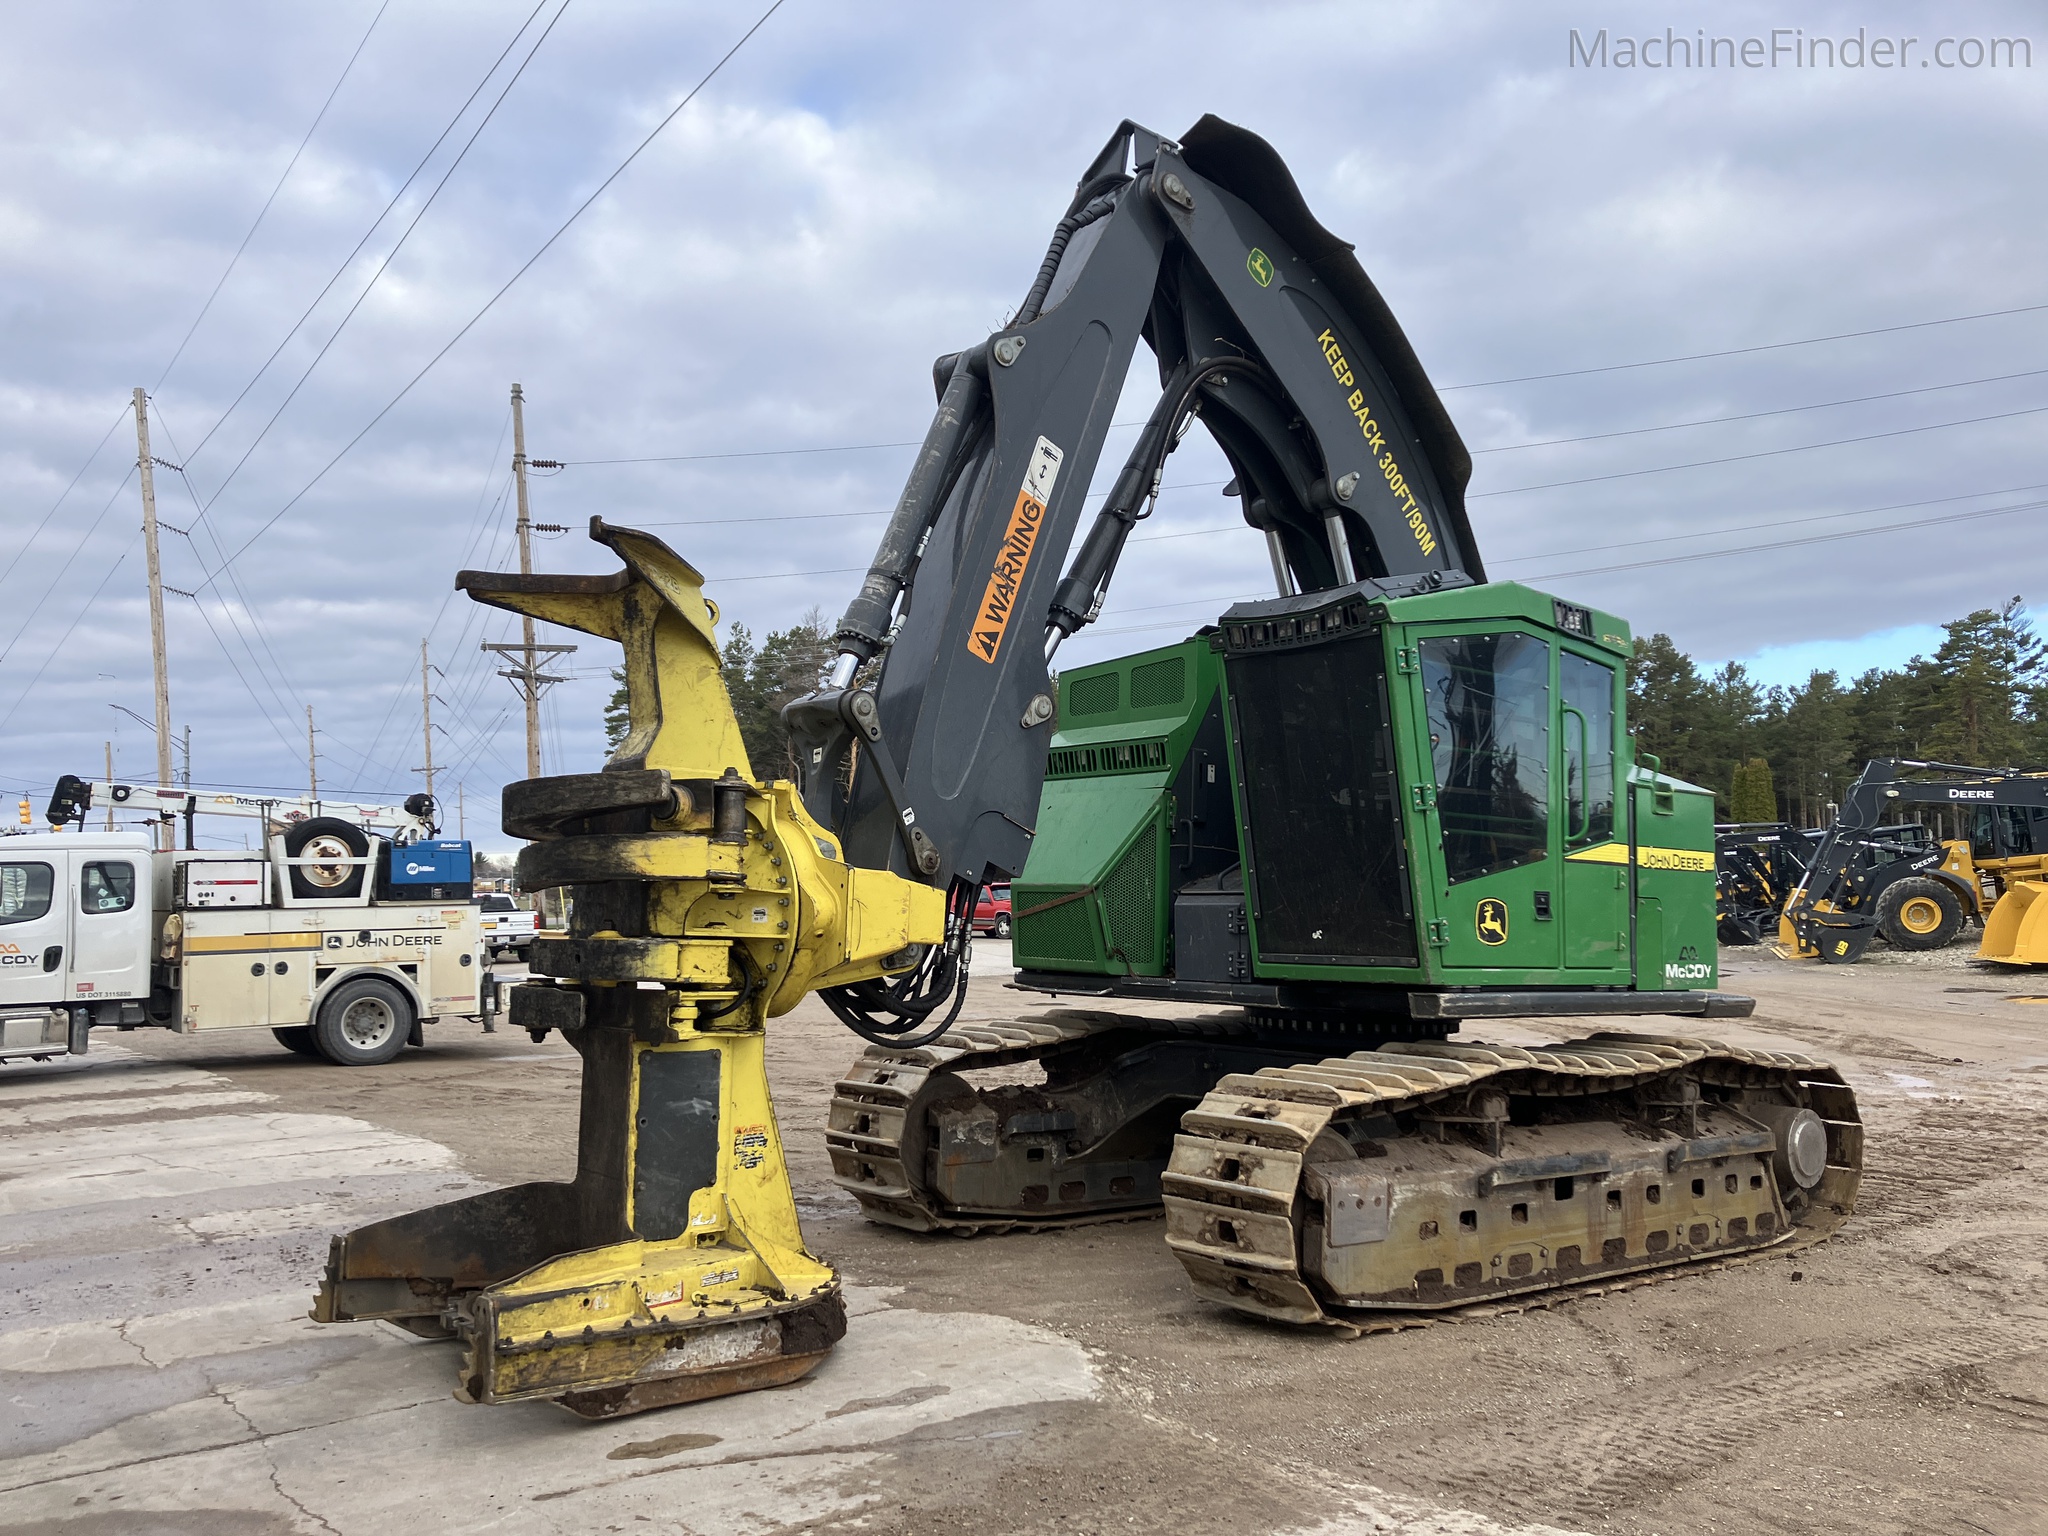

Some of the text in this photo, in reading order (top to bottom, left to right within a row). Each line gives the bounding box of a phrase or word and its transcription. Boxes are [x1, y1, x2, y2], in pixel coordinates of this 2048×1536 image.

[1316, 328, 1437, 557] KEEP BACK 300FT/90M
[984, 499, 1041, 624] WARNING
[1948, 788, 1995, 799] DEERE
[1643, 851, 1705, 870] JOHN DEERE
[1910, 854, 1940, 871] DEERE
[346, 934, 442, 948] JOHN DEERE
[0, 954, 39, 965] COY
[1664, 963, 1712, 979] McCOY
